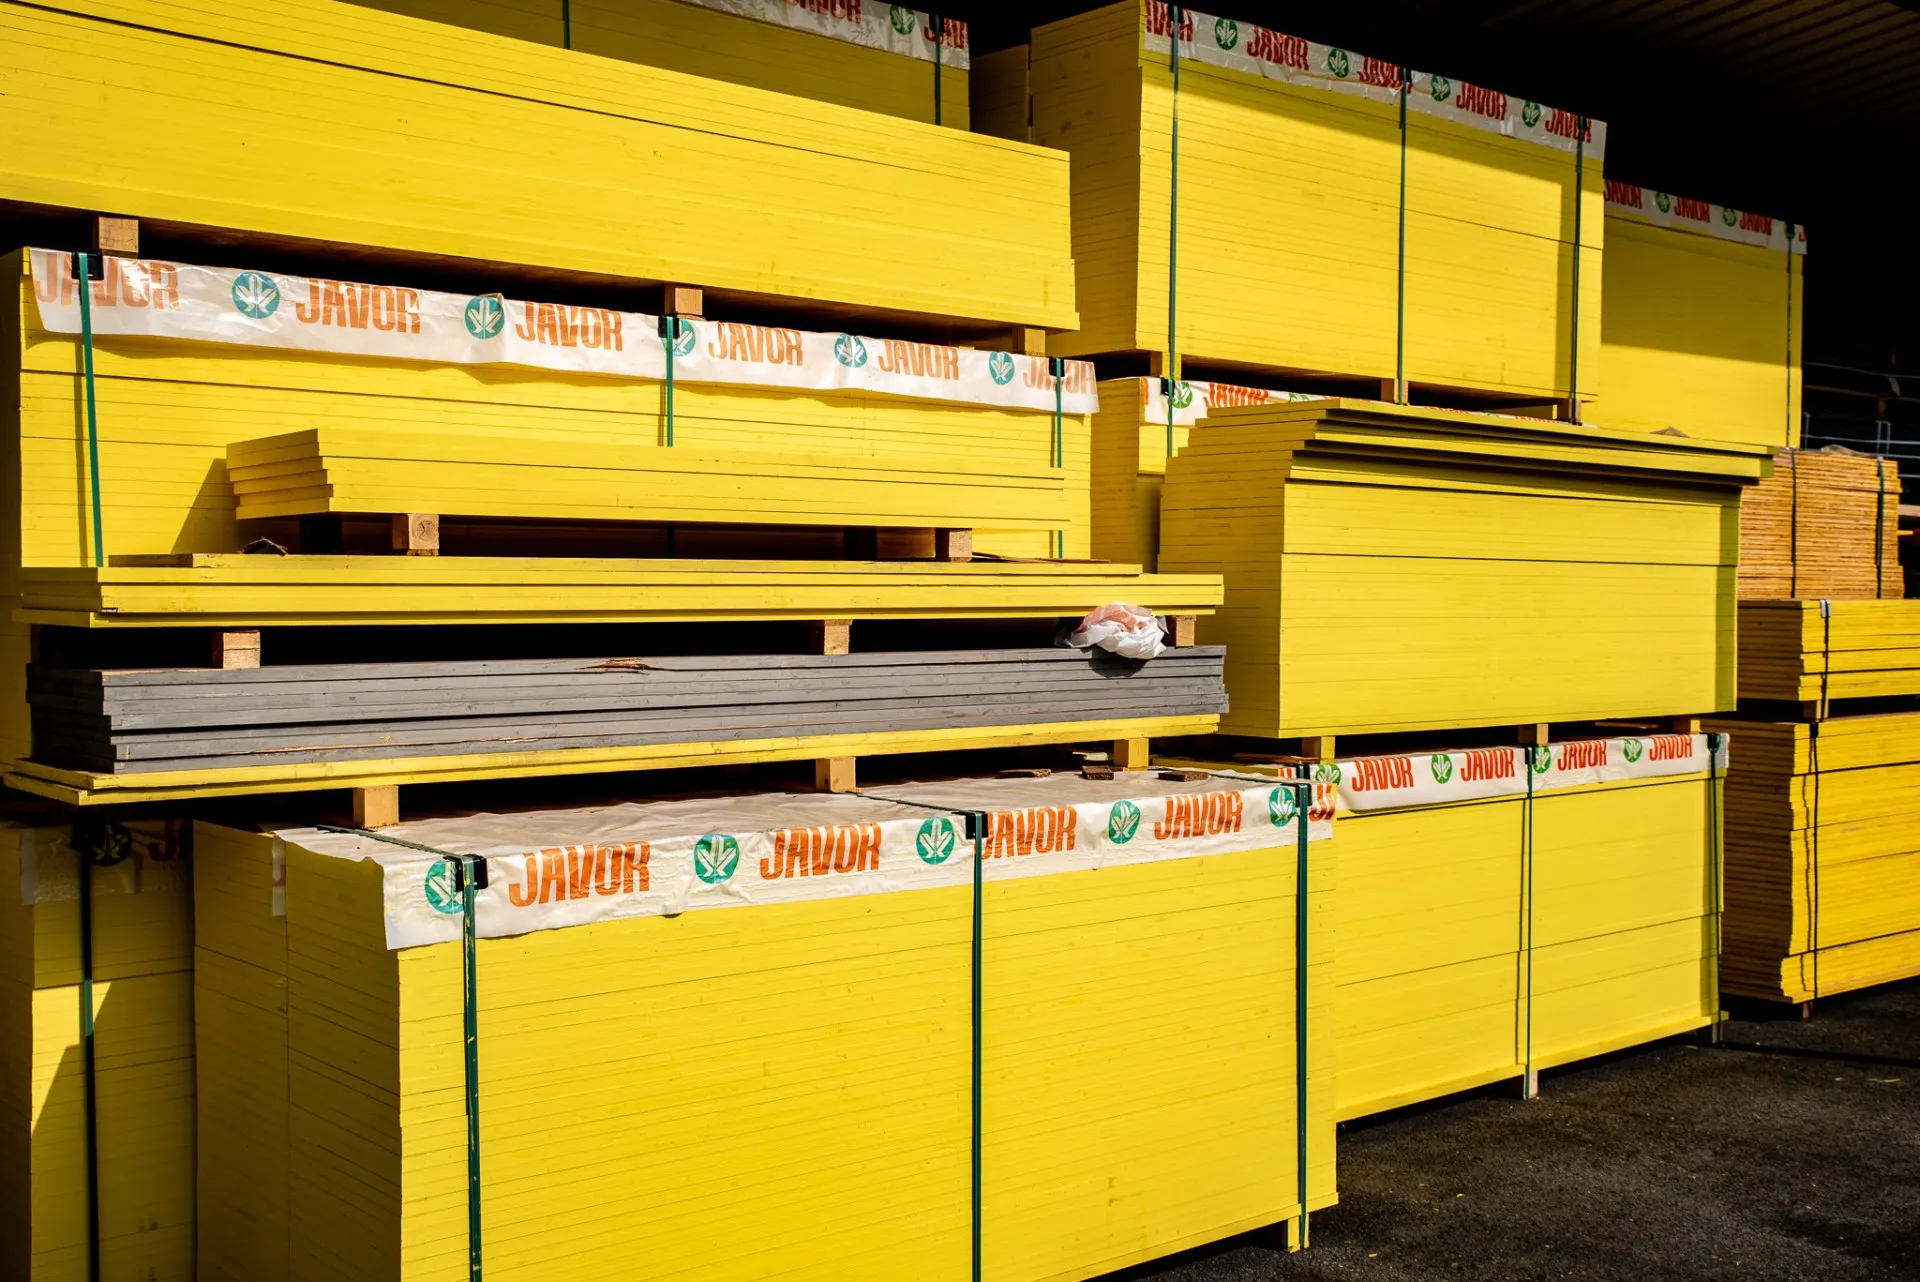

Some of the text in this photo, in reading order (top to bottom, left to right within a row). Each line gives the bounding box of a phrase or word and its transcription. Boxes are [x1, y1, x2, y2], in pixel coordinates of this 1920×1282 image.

[1247, 25, 1309, 71] JAVOR
[1357, 56, 1414, 94] JAVO
[1456, 81, 1507, 121] JAVOR
[1674, 197, 1710, 223] JAVOR
[1739, 211, 1772, 236] JAVOR
[295, 280, 421, 334] JAVOR
[515, 301, 623, 351] JAVOR
[708, 321, 803, 366] JAVOR
[877, 339, 959, 380] JAVOR
[1022, 357, 1097, 395] JAOR
[1203, 382, 1269, 408] JAVOR
[1352, 734, 1692, 792] JAVOR JAVOR JAVOR JAVOR
[508, 841, 650, 907] JAVOR
[760, 823, 882, 880] JAVOR
[1153, 791, 1243, 840] JAVOR
